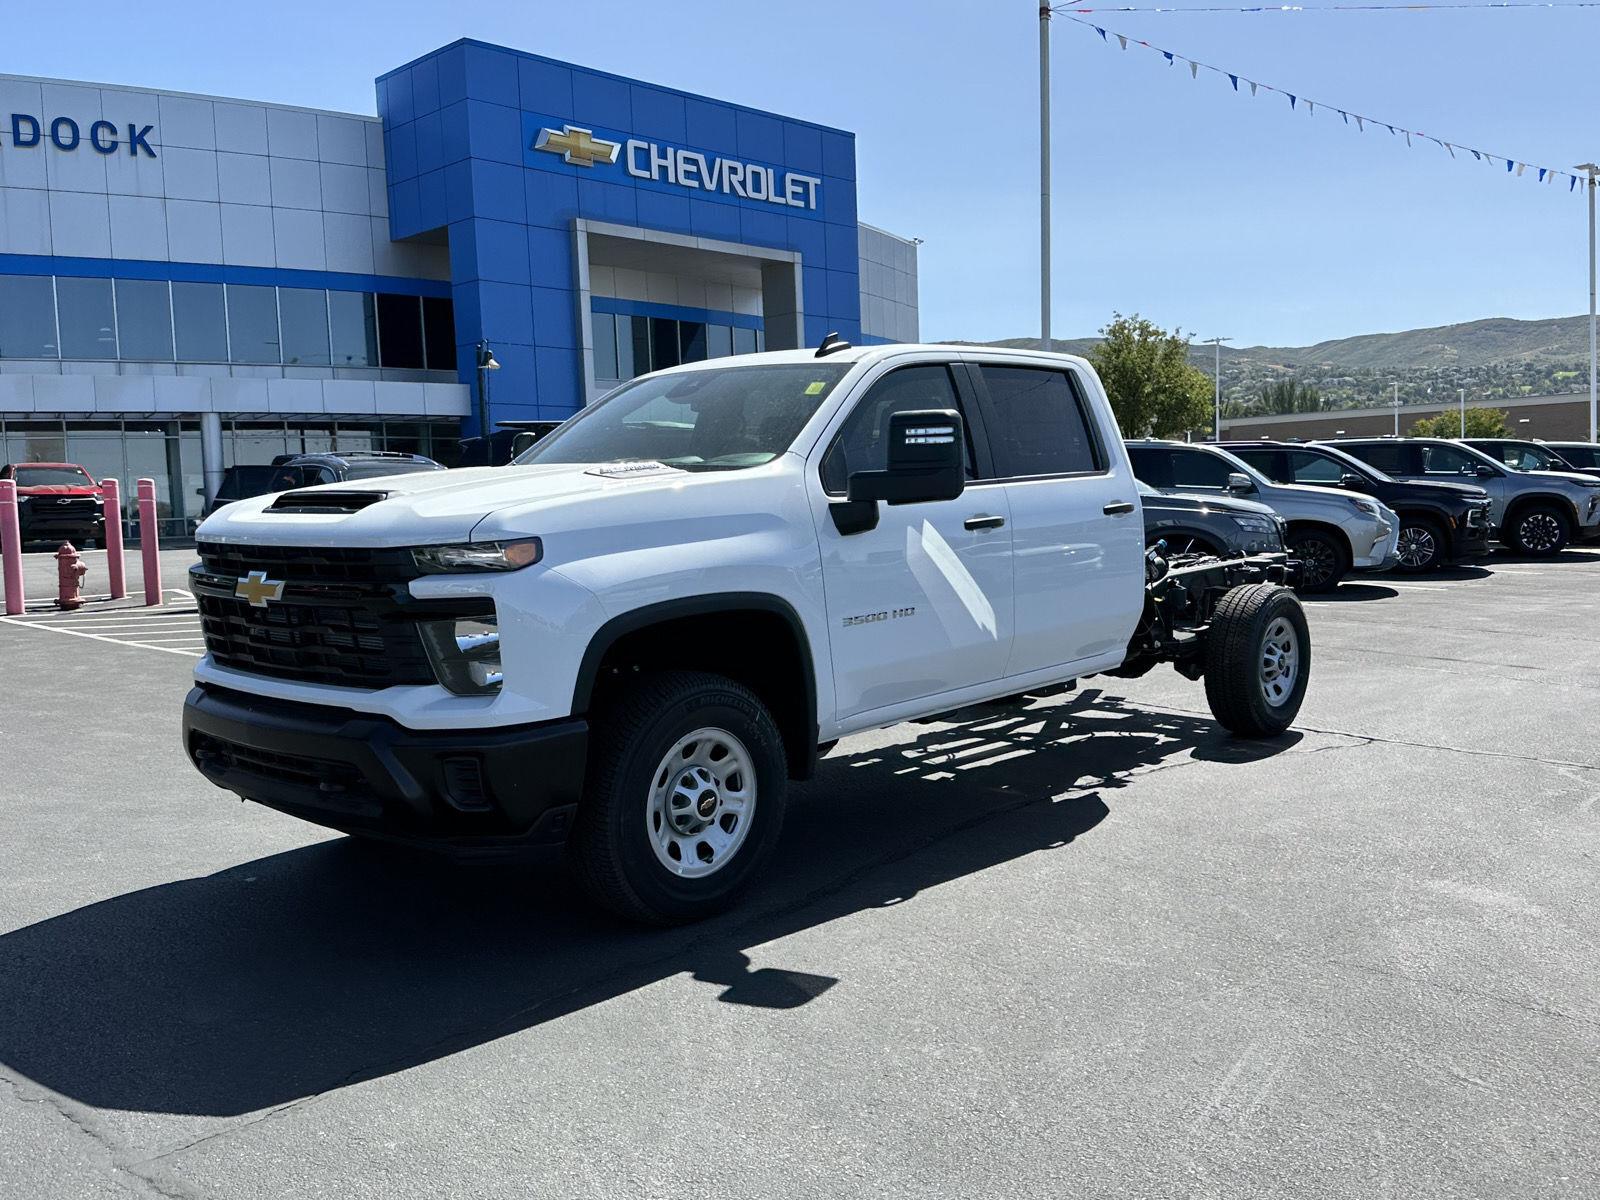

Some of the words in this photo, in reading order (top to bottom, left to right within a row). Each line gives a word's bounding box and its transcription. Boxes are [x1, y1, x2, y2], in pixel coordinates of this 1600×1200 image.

[0, 113, 157, 158] DOCK
[626, 138, 821, 210] CHEVROLET
[842, 611, 888, 627] 3500
[892, 607, 915, 619] HD
